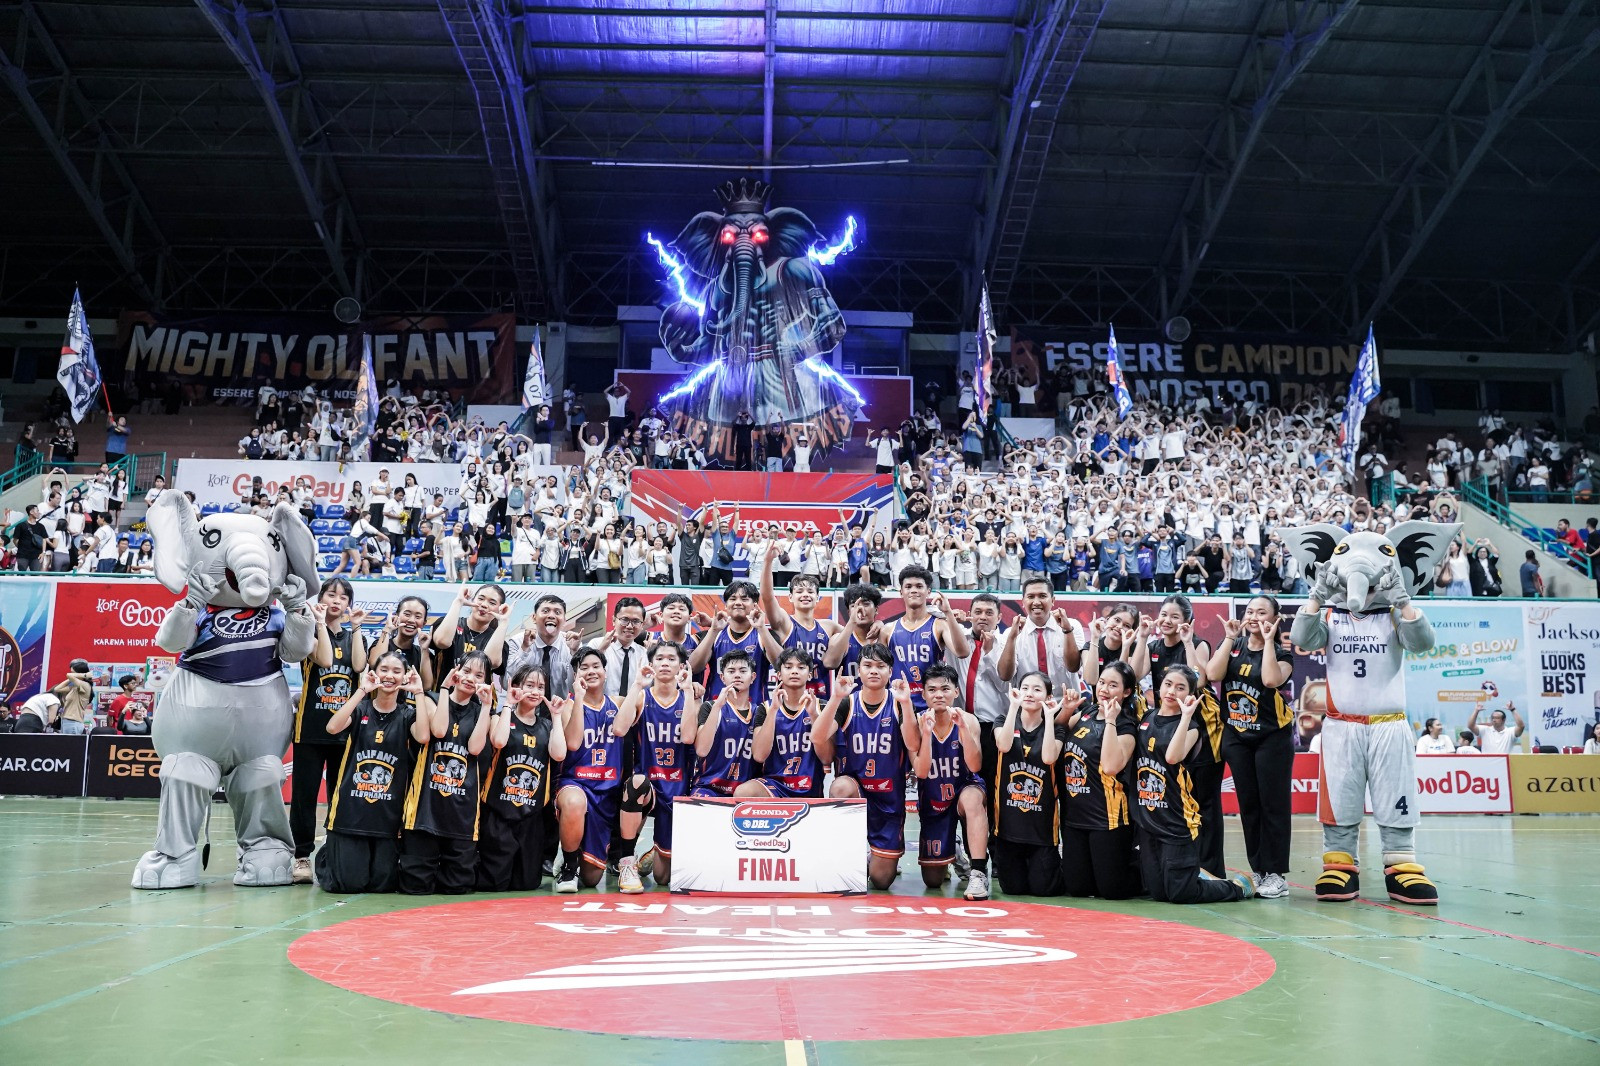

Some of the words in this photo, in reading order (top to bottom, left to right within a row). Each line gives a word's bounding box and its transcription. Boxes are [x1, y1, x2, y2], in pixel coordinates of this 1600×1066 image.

[125, 325, 299, 380] MIGHTY
[1195, 344, 1362, 376] CAMPION
[738, 519, 821, 532] HONDA
[119, 599, 171, 627] Goo
[216, 607, 270, 634] OLIFAN
[1537, 623, 1600, 640] Jackso
[93, 638, 124, 646] KARENA
[127, 638, 149, 646] HIDUP
[1332, 643, 1388, 654] OLIFANT
[1460, 643, 1471, 656] &
[1472, 638, 1518, 654] GLOW
[334, 647, 343, 659] 6
[1239, 663, 1253, 677] 11
[1353, 659, 1367, 678] 3
[1410, 664, 1427, 672] Stay
[1457, 659, 1473, 667] Stay
[1475, 654, 1512, 664] Protected
[1541, 653, 1586, 671] LOOKS
[318, 665, 352, 677] OLIFAN
[909, 665, 921, 682] 3
[1542, 673, 1586, 694] BEST
[1544, 717, 1578, 730] JACKSON
[375, 730, 385, 744] 5
[522, 733, 537, 748] 10
[775, 731, 812, 755] OHS
[852, 732, 892, 755] OHS
[356, 749, 399, 765] OLIFANT
[505, 754, 545, 772] OLIFANT
[591, 749, 607, 766] 13
[655, 748, 675, 766] 23
[783, 756, 802, 775] 27
[108, 763, 146, 777] ICE
[865, 759, 876, 777] 9
[357, 782, 388, 793] MIGHTY
[429, 781, 466, 796] LEPHANTS
[432, 773, 463, 788] MIGHTY
[1455, 770, 1500, 800] Day
[1527, 776, 1600, 793] azari
[350, 789, 392, 801] ELEPHANTS
[505, 785, 535, 798] MIGHTY
[940, 783, 956, 801] 10
[499, 794, 537, 807] ELEPHANTS
[1006, 799, 1042, 812] ELEPHANTS
[1395, 795, 1409, 815] 4
[751, 819, 770, 829] DBL
[753, 838, 772, 847] Good
[772, 839, 787, 848] Day
[926, 839, 942, 856] 10
[738, 857, 800, 881] FINAL
[850, 905, 1009, 918] One
[534, 922, 1045, 938] HONDA
